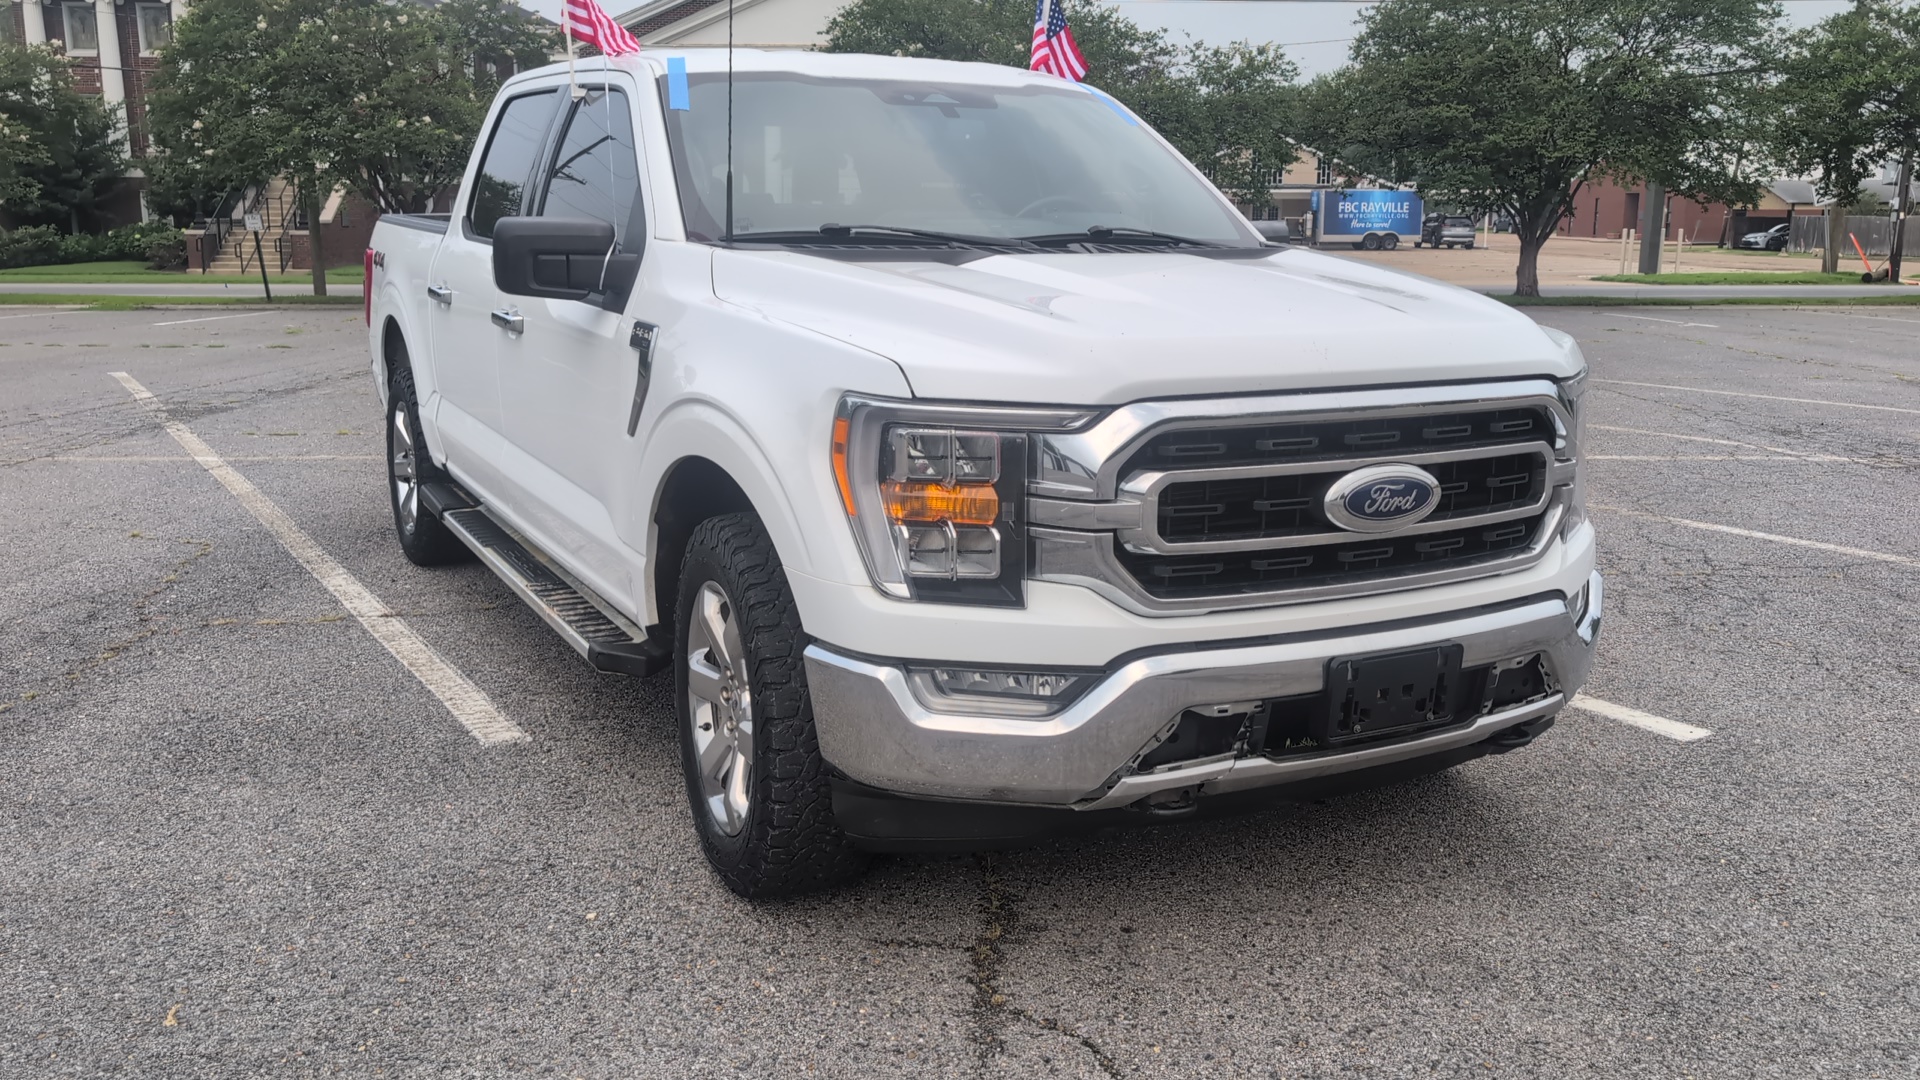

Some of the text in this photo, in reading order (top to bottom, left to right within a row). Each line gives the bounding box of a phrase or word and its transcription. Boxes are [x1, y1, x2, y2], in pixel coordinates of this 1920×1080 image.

[1338, 202, 1410, 213] FBC RAYVILLE
[1351, 219, 1365, 228] Here
[1364, 484, 1418, 514] Ford
